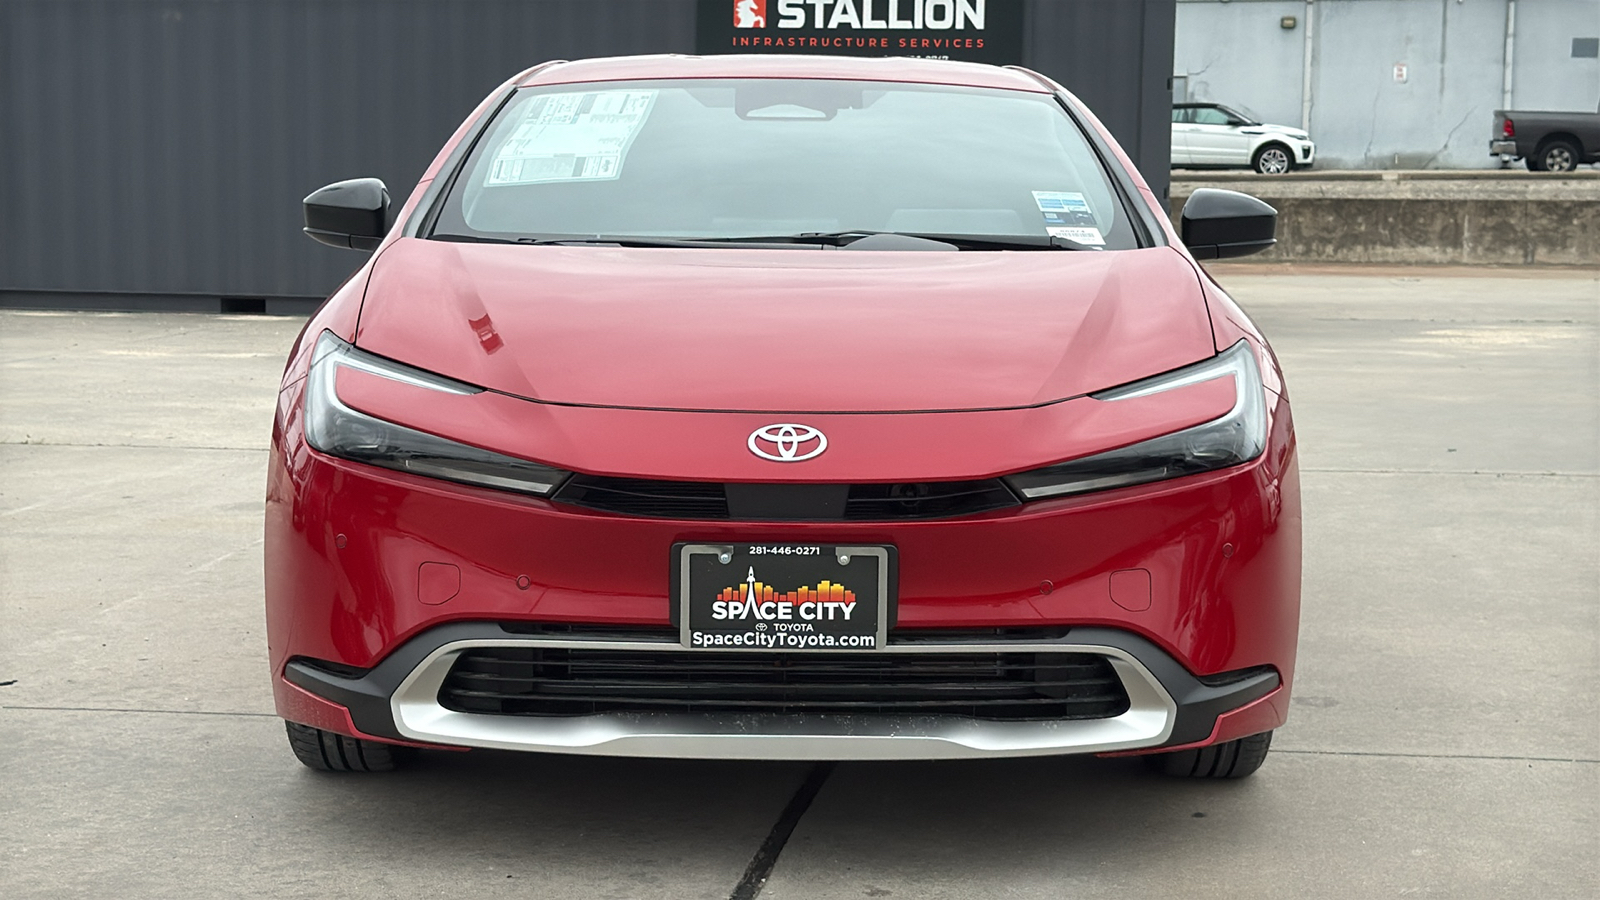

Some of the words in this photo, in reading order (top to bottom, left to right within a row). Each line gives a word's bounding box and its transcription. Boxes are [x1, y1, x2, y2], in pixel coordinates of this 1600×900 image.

[777, 0, 985, 29] STALLION
[732, 37, 888, 47] INFRASTRUCTURE
[898, 38, 985, 48] SERVICES
[749, 546, 820, 555] 281-446-0271
[712, 601, 793, 620] SPACE
[799, 602, 857, 620] CITY
[773, 623, 814, 632] TOYOTA
[692, 631, 875, 648] SpaceCityToyota.com
